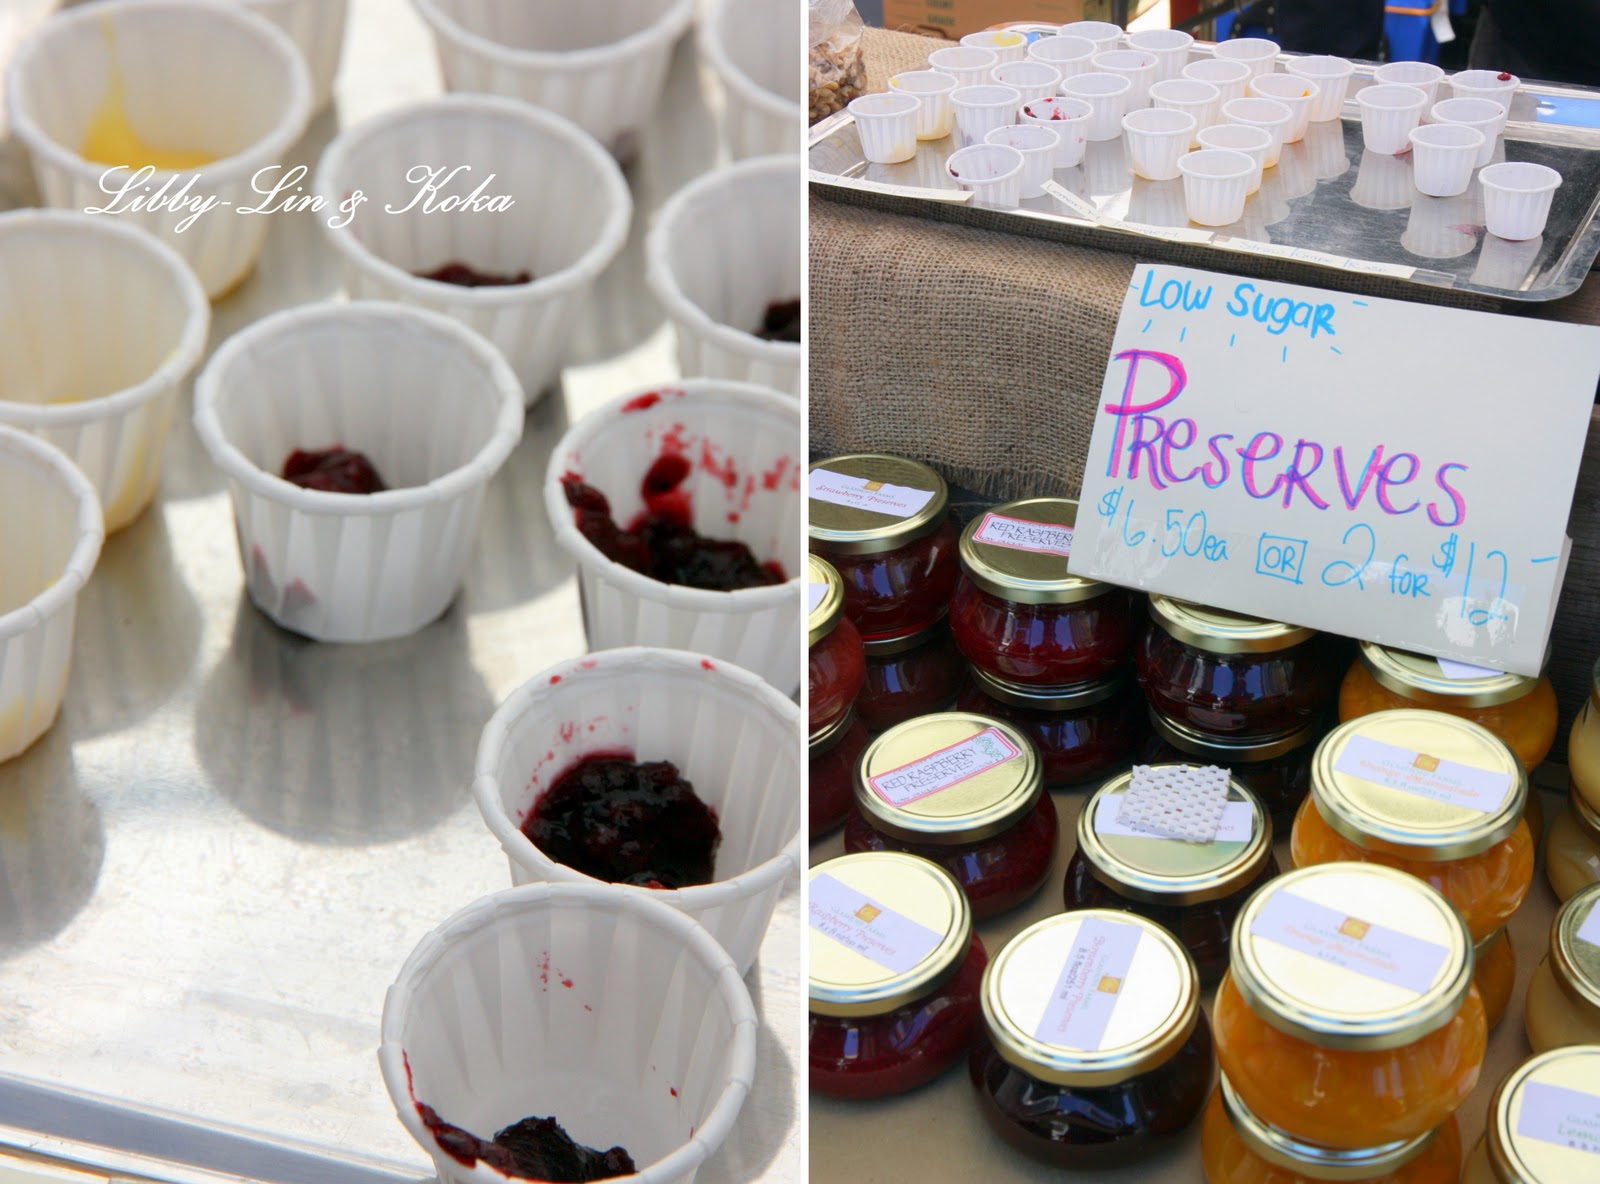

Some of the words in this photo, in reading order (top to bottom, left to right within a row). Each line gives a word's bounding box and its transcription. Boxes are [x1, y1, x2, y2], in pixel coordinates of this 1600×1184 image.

[815, 484, 864, 500] Strawberry
[867, 494, 908, 508] Preserves
[989, 521, 1015, 532] RED
[1000, 531, 1072, 548] PRESERVES
[1263, 545, 1297, 573] OR
[1321, 522, 1377, 592] 2
[880, 774, 907, 791] RED
[907, 747, 978, 781] RASPBERRY
[904, 760, 975, 793] PRESERVES
[855, 926, 897, 956] Preserves
